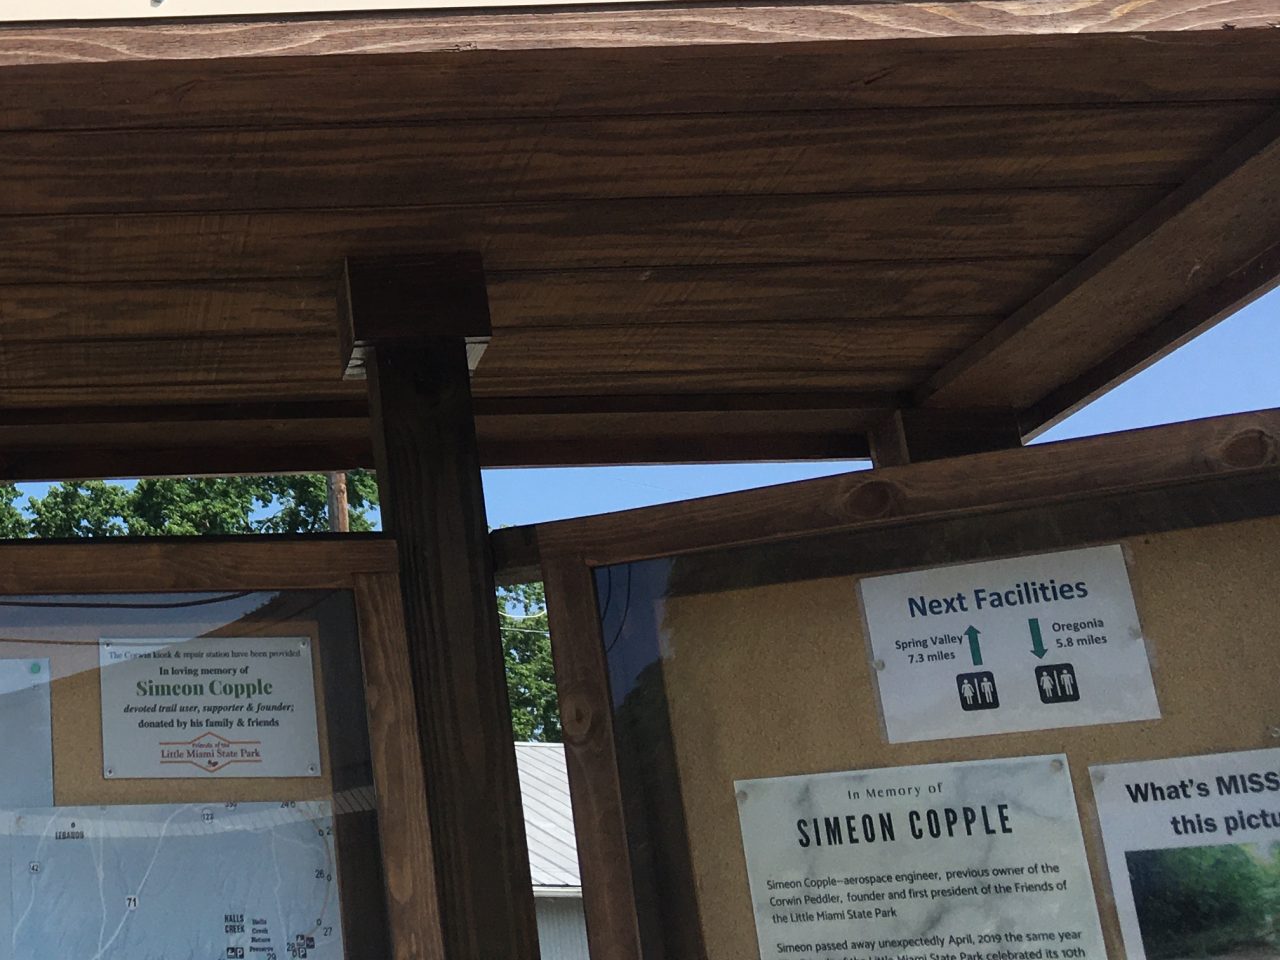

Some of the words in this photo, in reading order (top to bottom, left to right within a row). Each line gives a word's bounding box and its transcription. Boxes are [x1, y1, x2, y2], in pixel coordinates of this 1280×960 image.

[907, 592, 968, 617] Next
[974, 579, 1089, 610] Facilities
[1052, 618, 1104, 635] Oregonia
[895, 637, 929, 650] Spring
[930, 634, 964, 647] Valley
[1056, 637, 1074, 649] 5.8
[1076, 634, 1108, 647] miles
[231, 650, 249, 658] have
[250, 650, 267, 658] been
[269, 650, 301, 659] provided
[908, 653, 925, 664] 7.3
[927, 650, 956, 662] miles
[159, 666, 170, 675] In
[171, 666, 199, 677] loving
[200, 667, 238, 677] memory
[239, 666, 250, 675] of
[136, 679, 204, 697] Simeon
[209, 678, 273, 699] Copple
[123, 704, 157, 713] devoted
[158, 703, 178, 713] trail
[179, 705, 201, 714] user,
[202, 705, 244, 714] supporter
[246, 703, 254, 712] &
[255, 702, 295, 714] founder;
[138, 719, 174, 728] donated
[176, 719, 188, 729] by
[190, 718, 204, 728] his
[205, 718, 234, 729] family
[236, 718, 245, 728] &
[247, 718, 280, 727] friends
[161, 748, 184, 758] Little
[186, 748, 215, 758] Miami
[217, 748, 238, 758] State
[240, 748, 261, 758] Park
[848, 790, 860, 800] In
[866, 786, 921, 798] Memory
[928, 783, 943, 793] of
[1125, 778, 1210, 804] What's
[796, 812, 895, 848] SIMEON
[908, 804, 1013, 840] COPPLE
[1170, 813, 1218, 835] this
[767, 878, 802, 890] Simeon
[895, 872, 942, 886] engineer,
[946, 868, 990, 880] previous
[992, 866, 1025, 877] owner
[1028, 863, 1039, 874] of
[1041, 863, 1060, 873] the
[769, 895, 802, 907] Corwin
[804, 893, 843, 905] Peddler,
[847, 890, 885, 902] founder
[888, 889, 906, 900] and
[908, 887, 928, 899] first
[931, 885, 979, 900] president
[981, 882, 992, 894] of
[994, 883, 1012, 894] the
[1014, 881, 1054, 893] Friends
[1056, 879, 1067, 891] of
[127, 897, 137, 908] 71
[224, 914, 244, 923] HALLS
[772, 913, 788, 924] the
[790, 911, 815, 923] Little
[817, 909, 845, 921] Miami
[847, 908, 873, 920] State
[874, 906, 898, 918] Park
[225, 924, 245, 934] CREEK
[323, 927, 333, 937] 27
[776, 942, 812, 954] Simeon
[815, 939, 848, 953] passed
[851, 940, 875, 951] away
[878, 935, 945, 950] unexpectedly
[948, 934, 975, 948] April,
[978, 933, 1002, 944] 2019
[1004, 931, 1023, 942] the
[1025, 931, 1056, 942] same
[1058, 930, 1082, 943] year
[960, 951, 983, 960] Park
[986, 948, 1043, 960] celebrated
[1045, 947, 1059, 959] its
[1062, 947, 1086, 959] 10th
